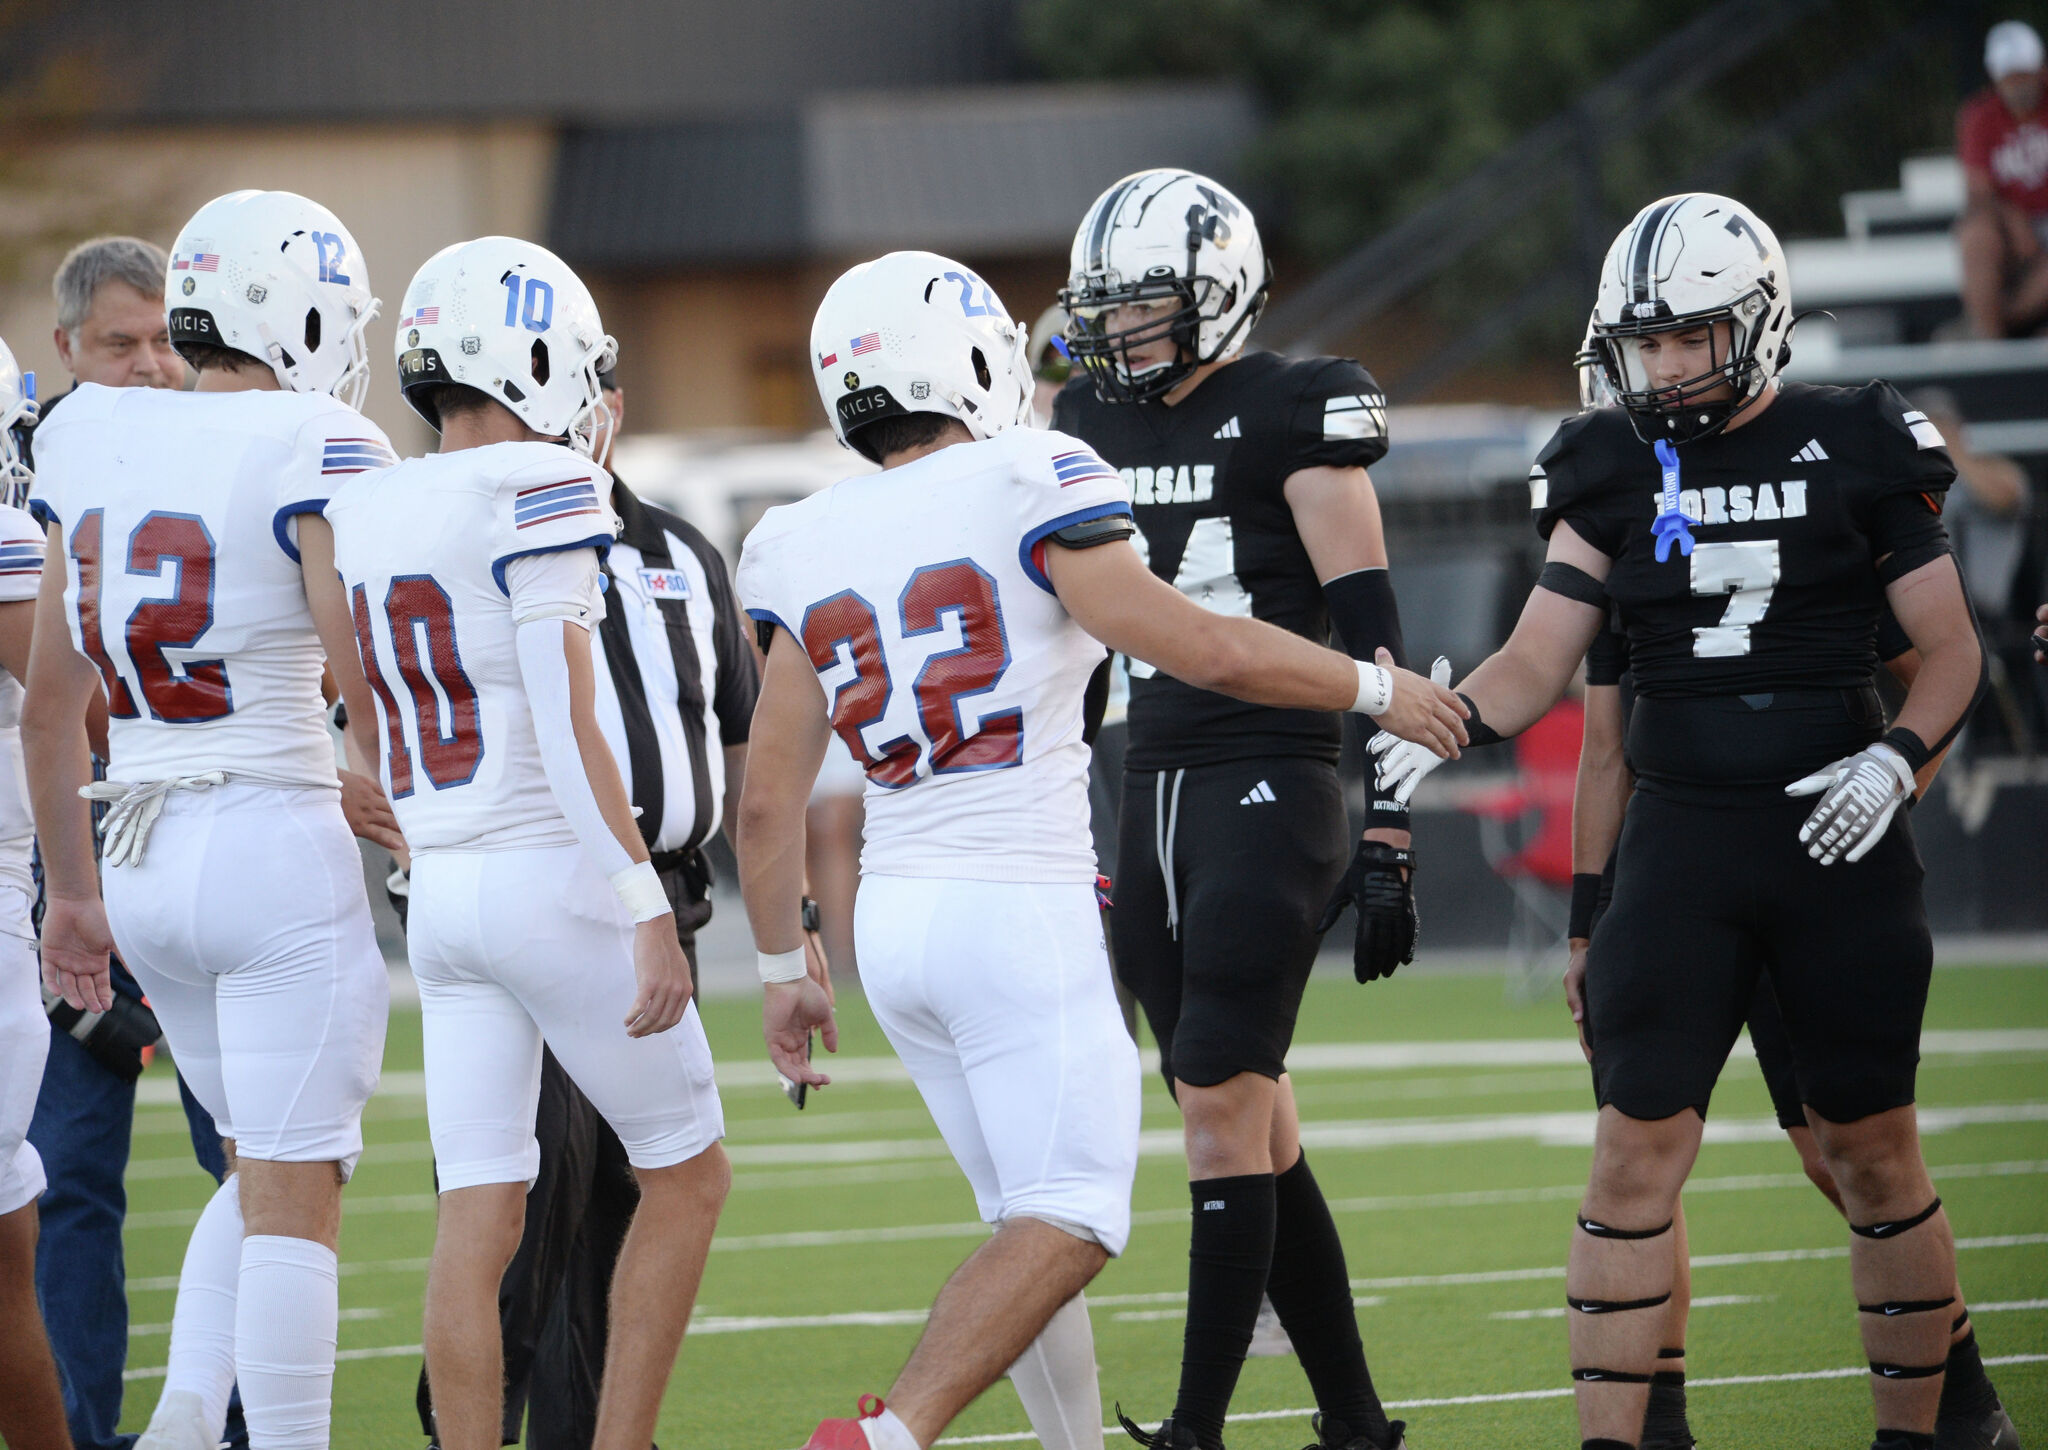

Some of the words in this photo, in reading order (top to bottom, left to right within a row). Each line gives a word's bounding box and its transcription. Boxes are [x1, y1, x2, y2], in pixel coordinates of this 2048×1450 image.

[311, 231, 350, 286] 12
[1724, 214, 1769, 263] 7
[505, 274, 553, 333] 10
[944, 271, 1002, 318] 22
[170, 315, 210, 333] VICIS
[400, 356, 437, 377] VICIS
[839, 393, 887, 420] VICIS
[1117, 464, 1216, 505] ORSAN
[1664, 471, 1677, 511] NXTRND
[70, 508, 235, 723] 12
[1690, 539, 1781, 658] 7
[351, 573, 486, 799] 10
[802, 556, 1025, 788] 22
